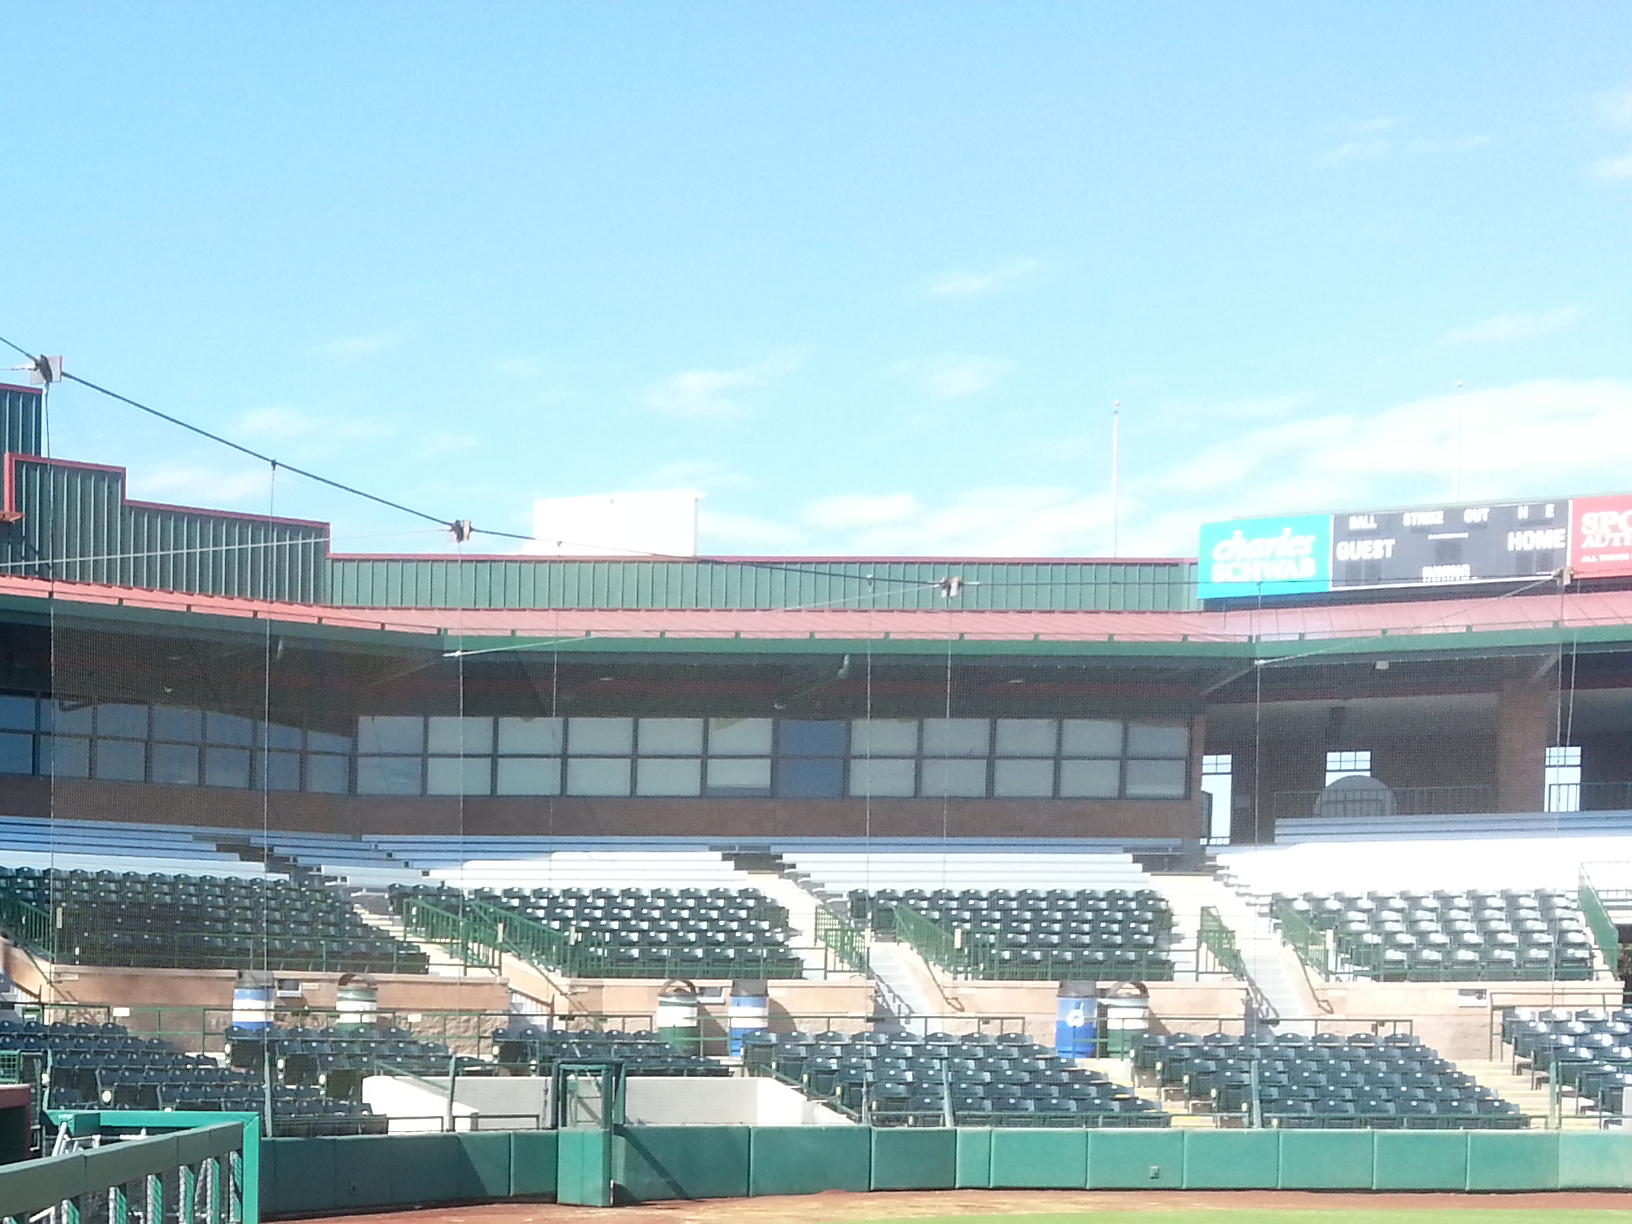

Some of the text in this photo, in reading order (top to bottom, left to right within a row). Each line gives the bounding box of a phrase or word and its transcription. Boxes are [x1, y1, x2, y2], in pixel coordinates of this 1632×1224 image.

[1349, 507, 1490, 530] BALL STRIKE OUT
[1212, 526, 1317, 561] charles
[1336, 538, 1396, 560] GUEST
[1507, 528, 1566, 551] HOME
[1211, 557, 1317, 583] SCHWAB
